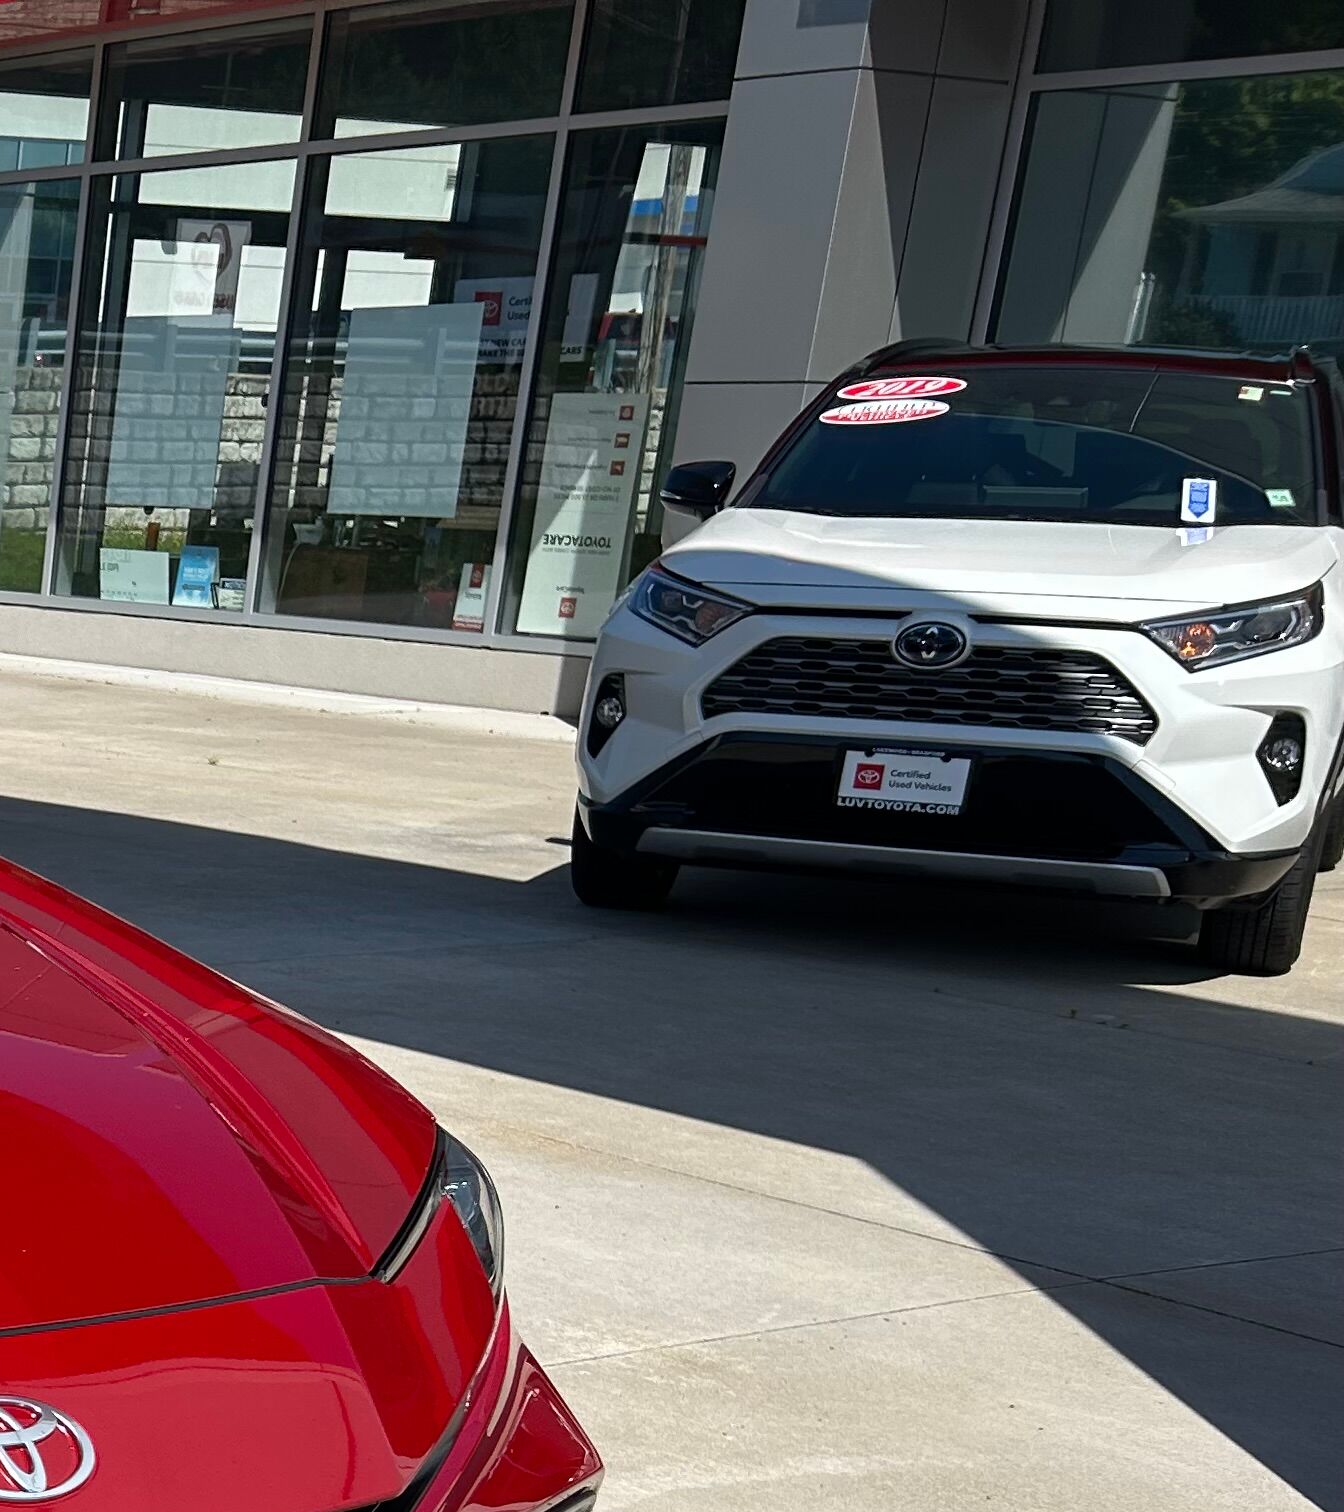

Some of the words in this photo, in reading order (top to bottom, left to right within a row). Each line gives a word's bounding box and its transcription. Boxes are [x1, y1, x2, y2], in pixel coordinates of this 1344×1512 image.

[854, 380, 948, 397] 2019
[542, 534, 612, 548] TOYOTACARE
[890, 769, 932, 780] Certified
[888, 780, 912, 789] Used
[914, 781, 952, 792] Vehicles
[837, 797, 959, 816] LUVTOYOTA.COM
